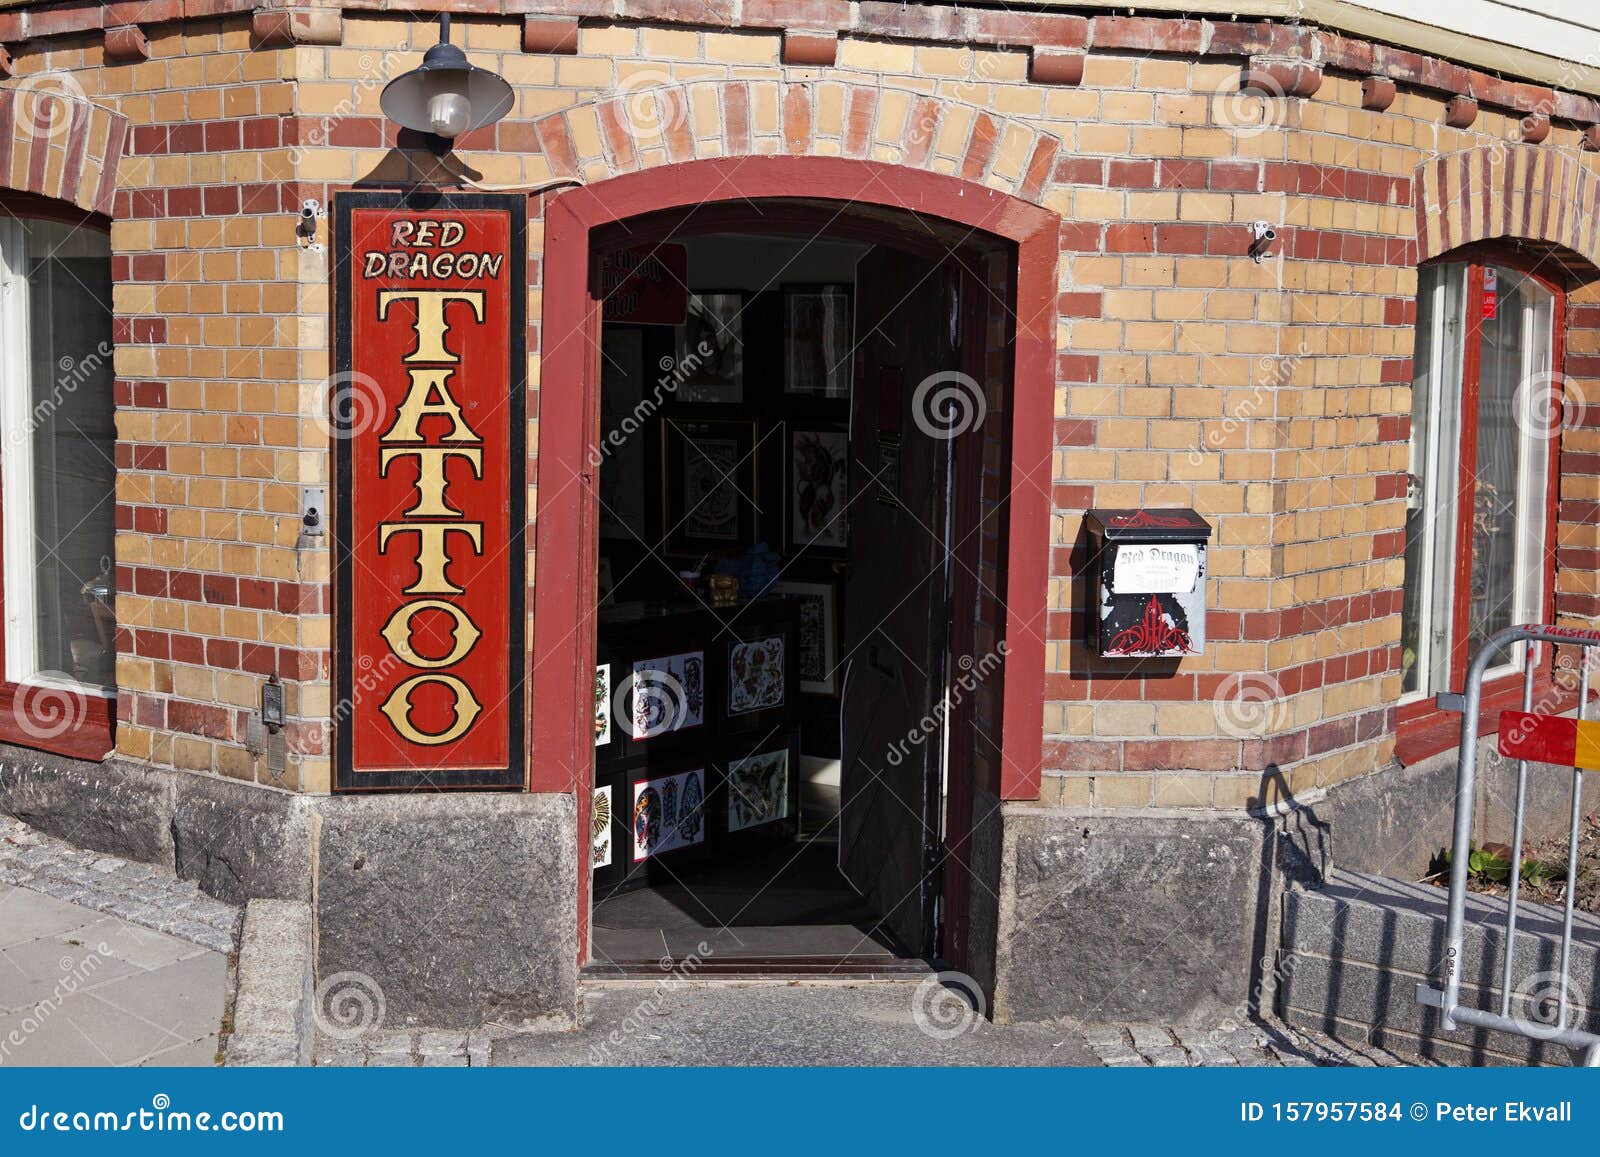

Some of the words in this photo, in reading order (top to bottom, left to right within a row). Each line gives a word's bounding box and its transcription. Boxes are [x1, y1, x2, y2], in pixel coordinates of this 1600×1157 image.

[391, 219, 466, 248] RED
[364, 251, 504, 281] DRAGON
[376, 288, 487, 746] TATTOO
[1149, 547, 1194, 565] Dragon
